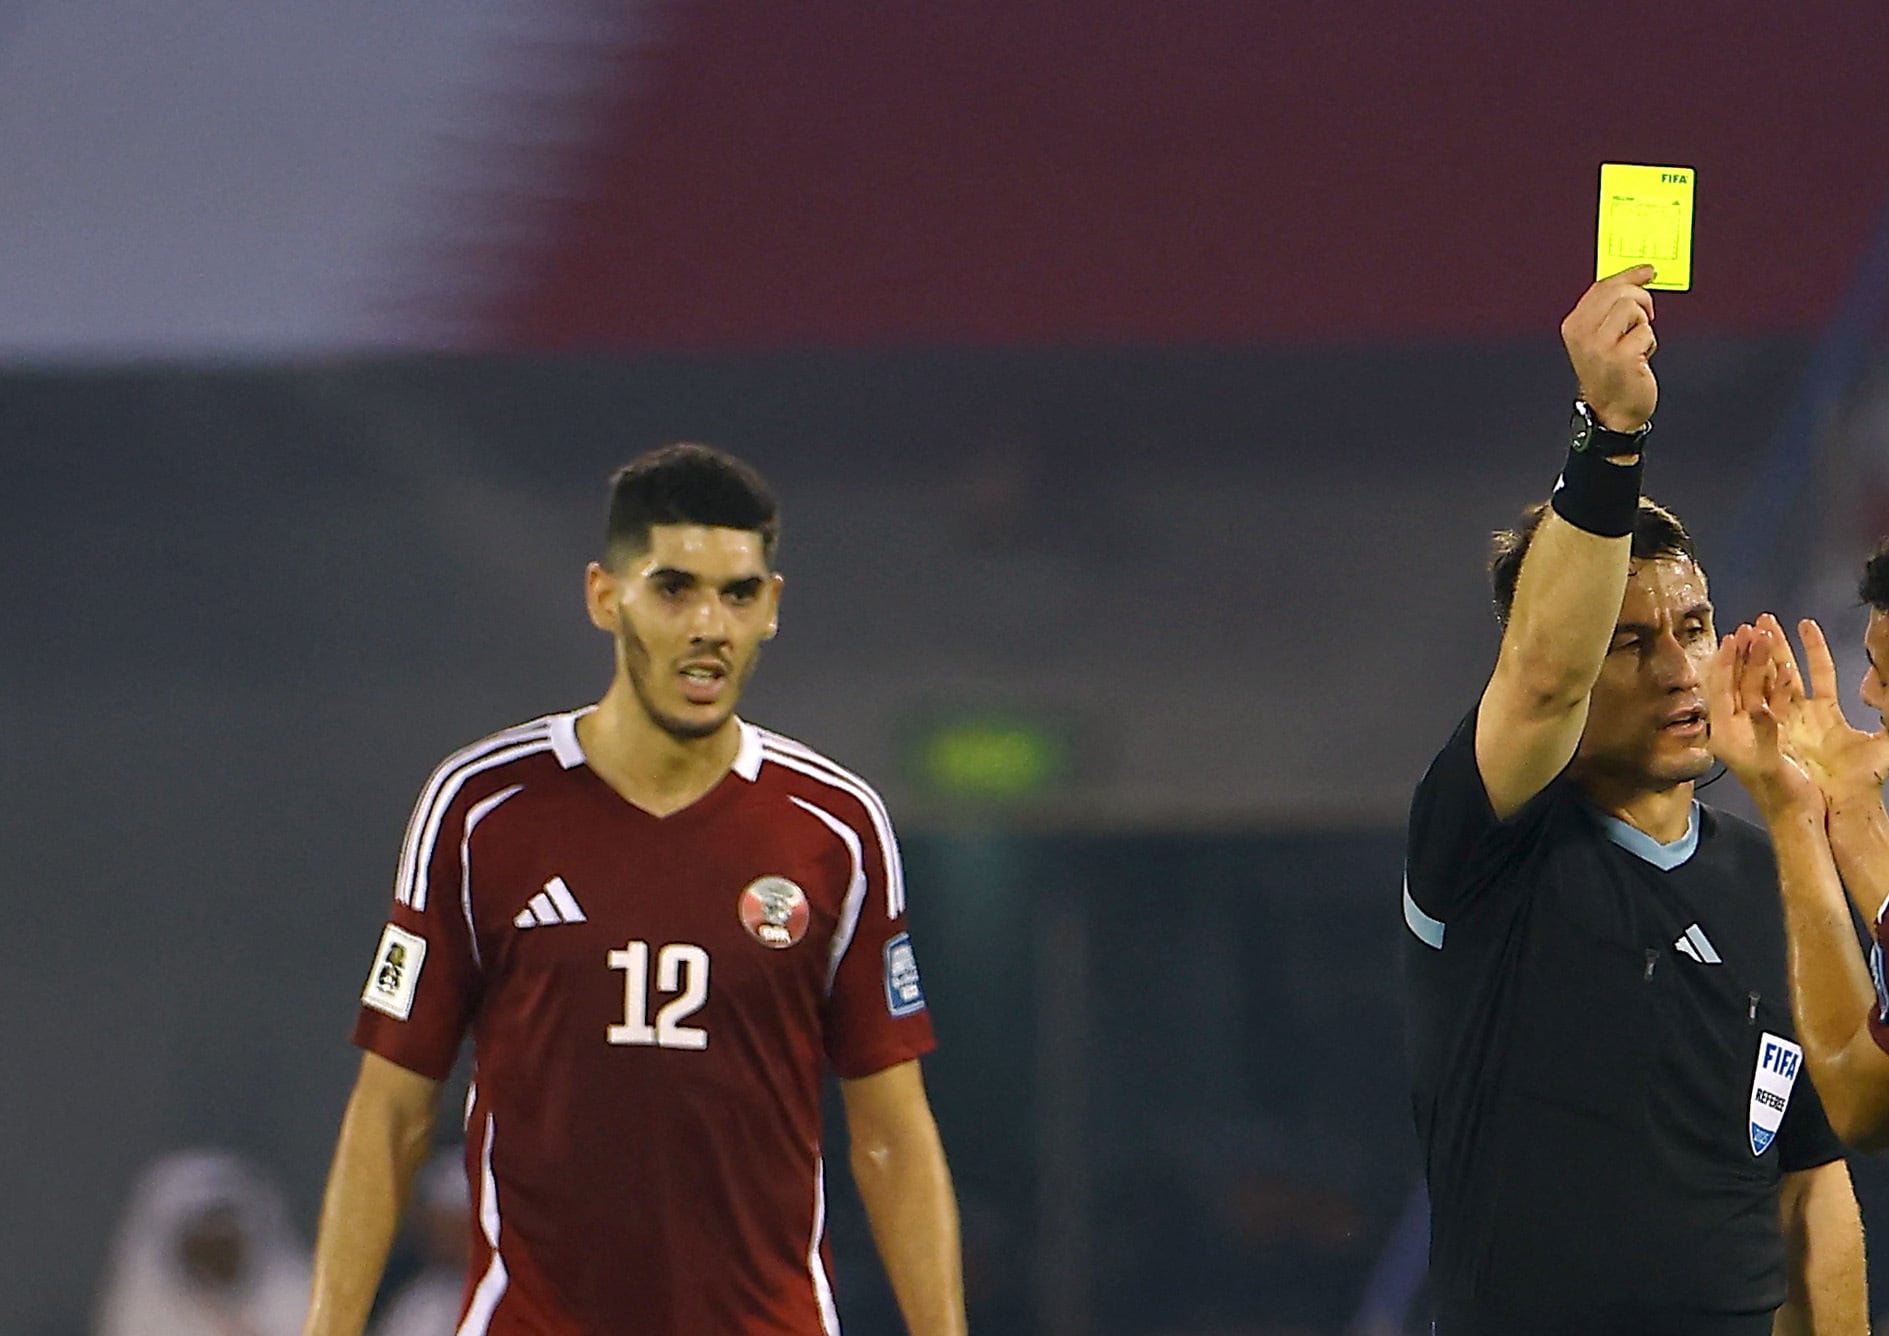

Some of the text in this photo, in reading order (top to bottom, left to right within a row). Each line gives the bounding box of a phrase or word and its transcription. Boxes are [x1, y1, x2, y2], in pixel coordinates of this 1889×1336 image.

[1661, 173, 1688, 184] FIFA
[606, 940, 710, 1051] 12
[1762, 1042, 1799, 1081] FIFA
[1755, 1087, 1786, 1113] REFEREE
